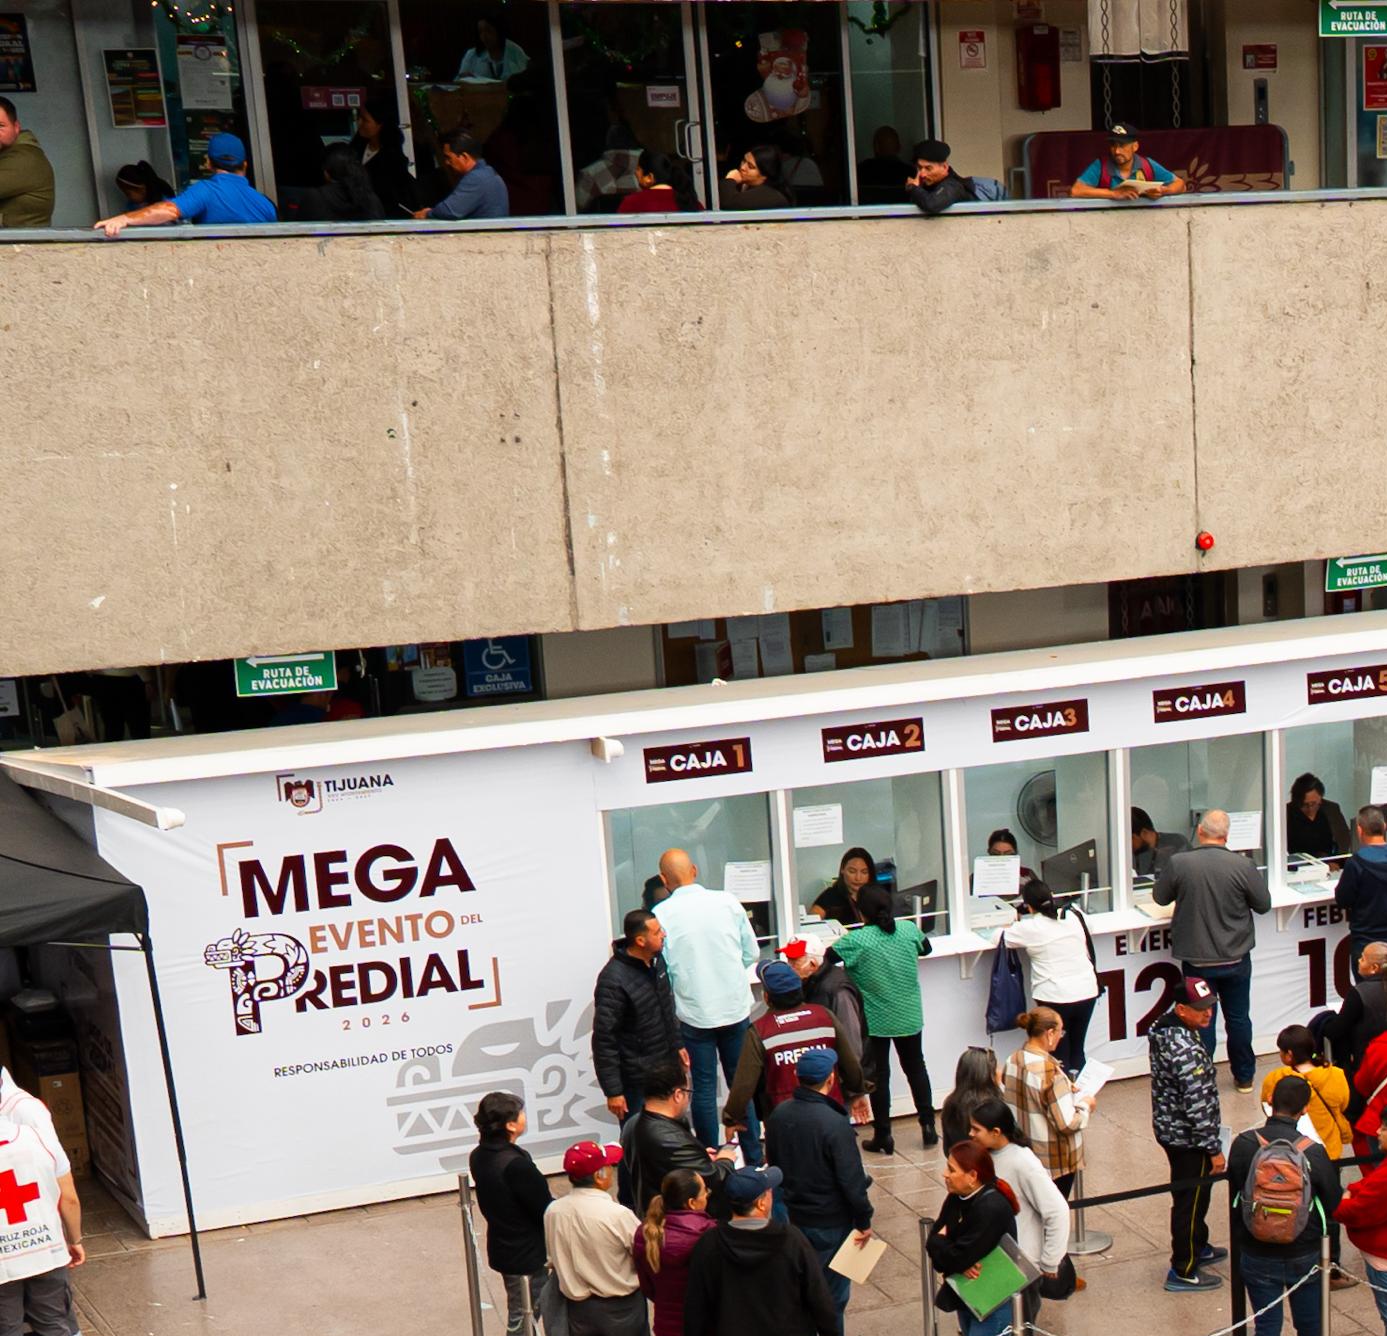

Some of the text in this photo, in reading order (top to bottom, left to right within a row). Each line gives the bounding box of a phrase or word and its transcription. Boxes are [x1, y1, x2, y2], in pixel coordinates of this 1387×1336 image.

[1331, 19, 1386, 31] EVACUACIÓN
[1341, 12, 1376, 21] RUTA DE
[1337, 572, 1387, 587] EVACUACIÓN
[1347, 565, 1380, 577] RUTA DE
[262, 666, 309, 679] RUTA DE
[485, 673, 513, 683] CAJA
[251, 675, 323, 690] EVACUACIÓN
[472, 680, 526, 693] EXCLUSIVA
[1328, 674, 1375, 695] CAJA
[1175, 693, 1224, 713] CAJA
[1222, 688, 1235, 708] 4
[1014, 711, 1066, 732] CAJA
[1065, 708, 1077, 727] 3
[846, 729, 901, 752] CAJA
[904, 723, 922, 748] 2
[669, 748, 727, 773] CAJA
[731, 744, 745, 768] 1
[325, 773, 394, 792] TIJUANA
[239, 837, 476, 918] MEGA
[309, 909, 483, 954] EVENTO DEL
[203, 928, 485, 1036] PREDIAL
[342, 1012, 410, 1030] 2026
[274, 1043, 453, 1078] RESPONSABILIDAD DE TODOS
[0, 1224, 49, 1243] RUZ ROJA
